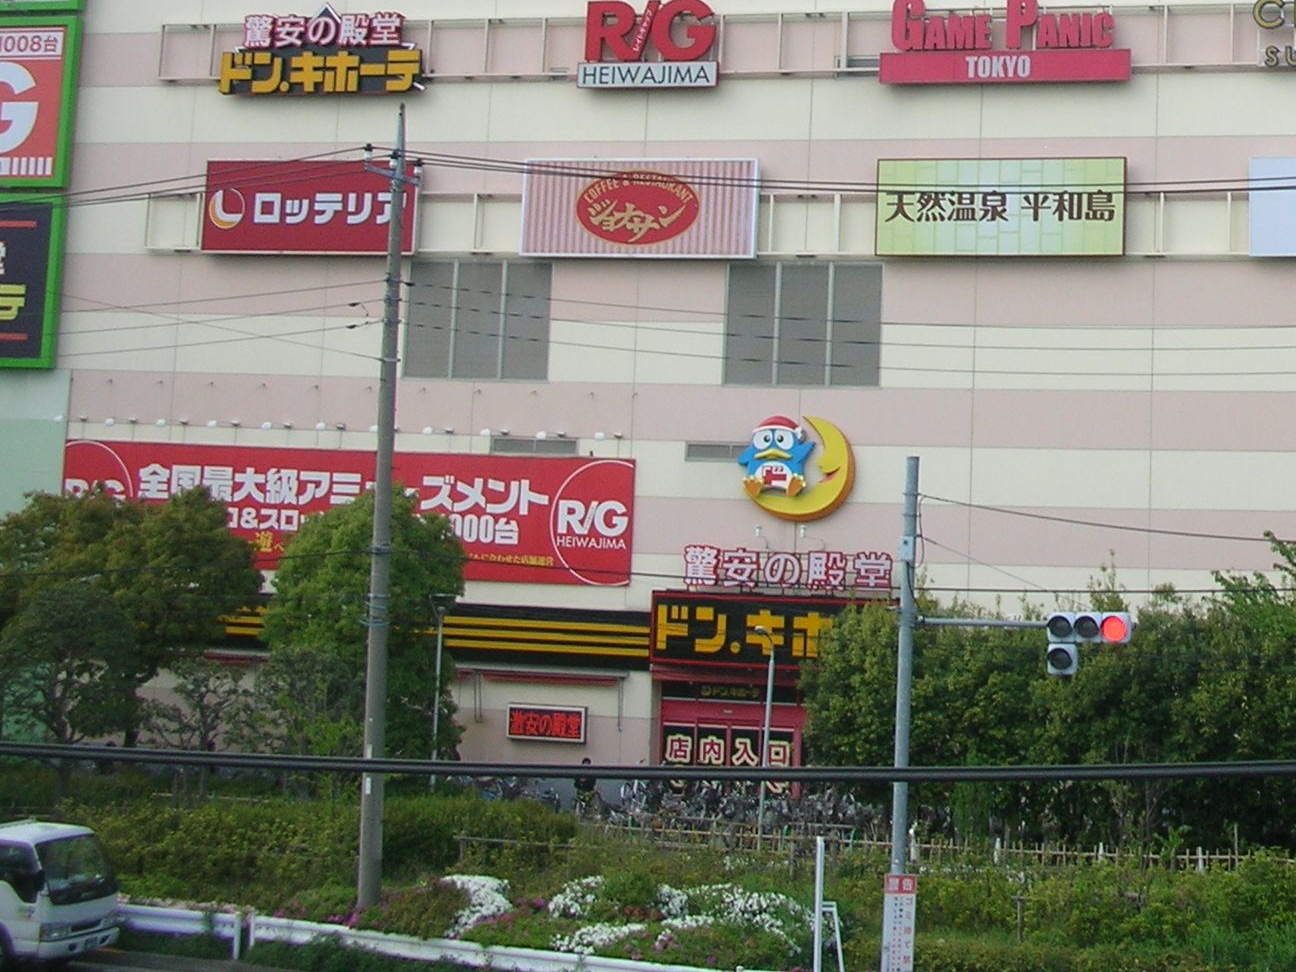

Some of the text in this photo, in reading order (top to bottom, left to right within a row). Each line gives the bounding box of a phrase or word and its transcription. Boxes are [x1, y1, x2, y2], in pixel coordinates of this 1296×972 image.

[244, 13, 403, 47] 驚安の殿堂
[582, 65, 710, 85] HEIWAJIMA
[966, 55, 1031, 78] TOKYO
[583, 178, 619, 203] COFFEE
[254, 193, 407, 224] ロッテリア
[884, 191, 1116, 222] 天然温泉 平和島
[556, 536, 626, 549] HEIWAJIMA
[685, 546, 892, 592] 驚安の殿堂
[667, 735, 790, 765] 店内入口
